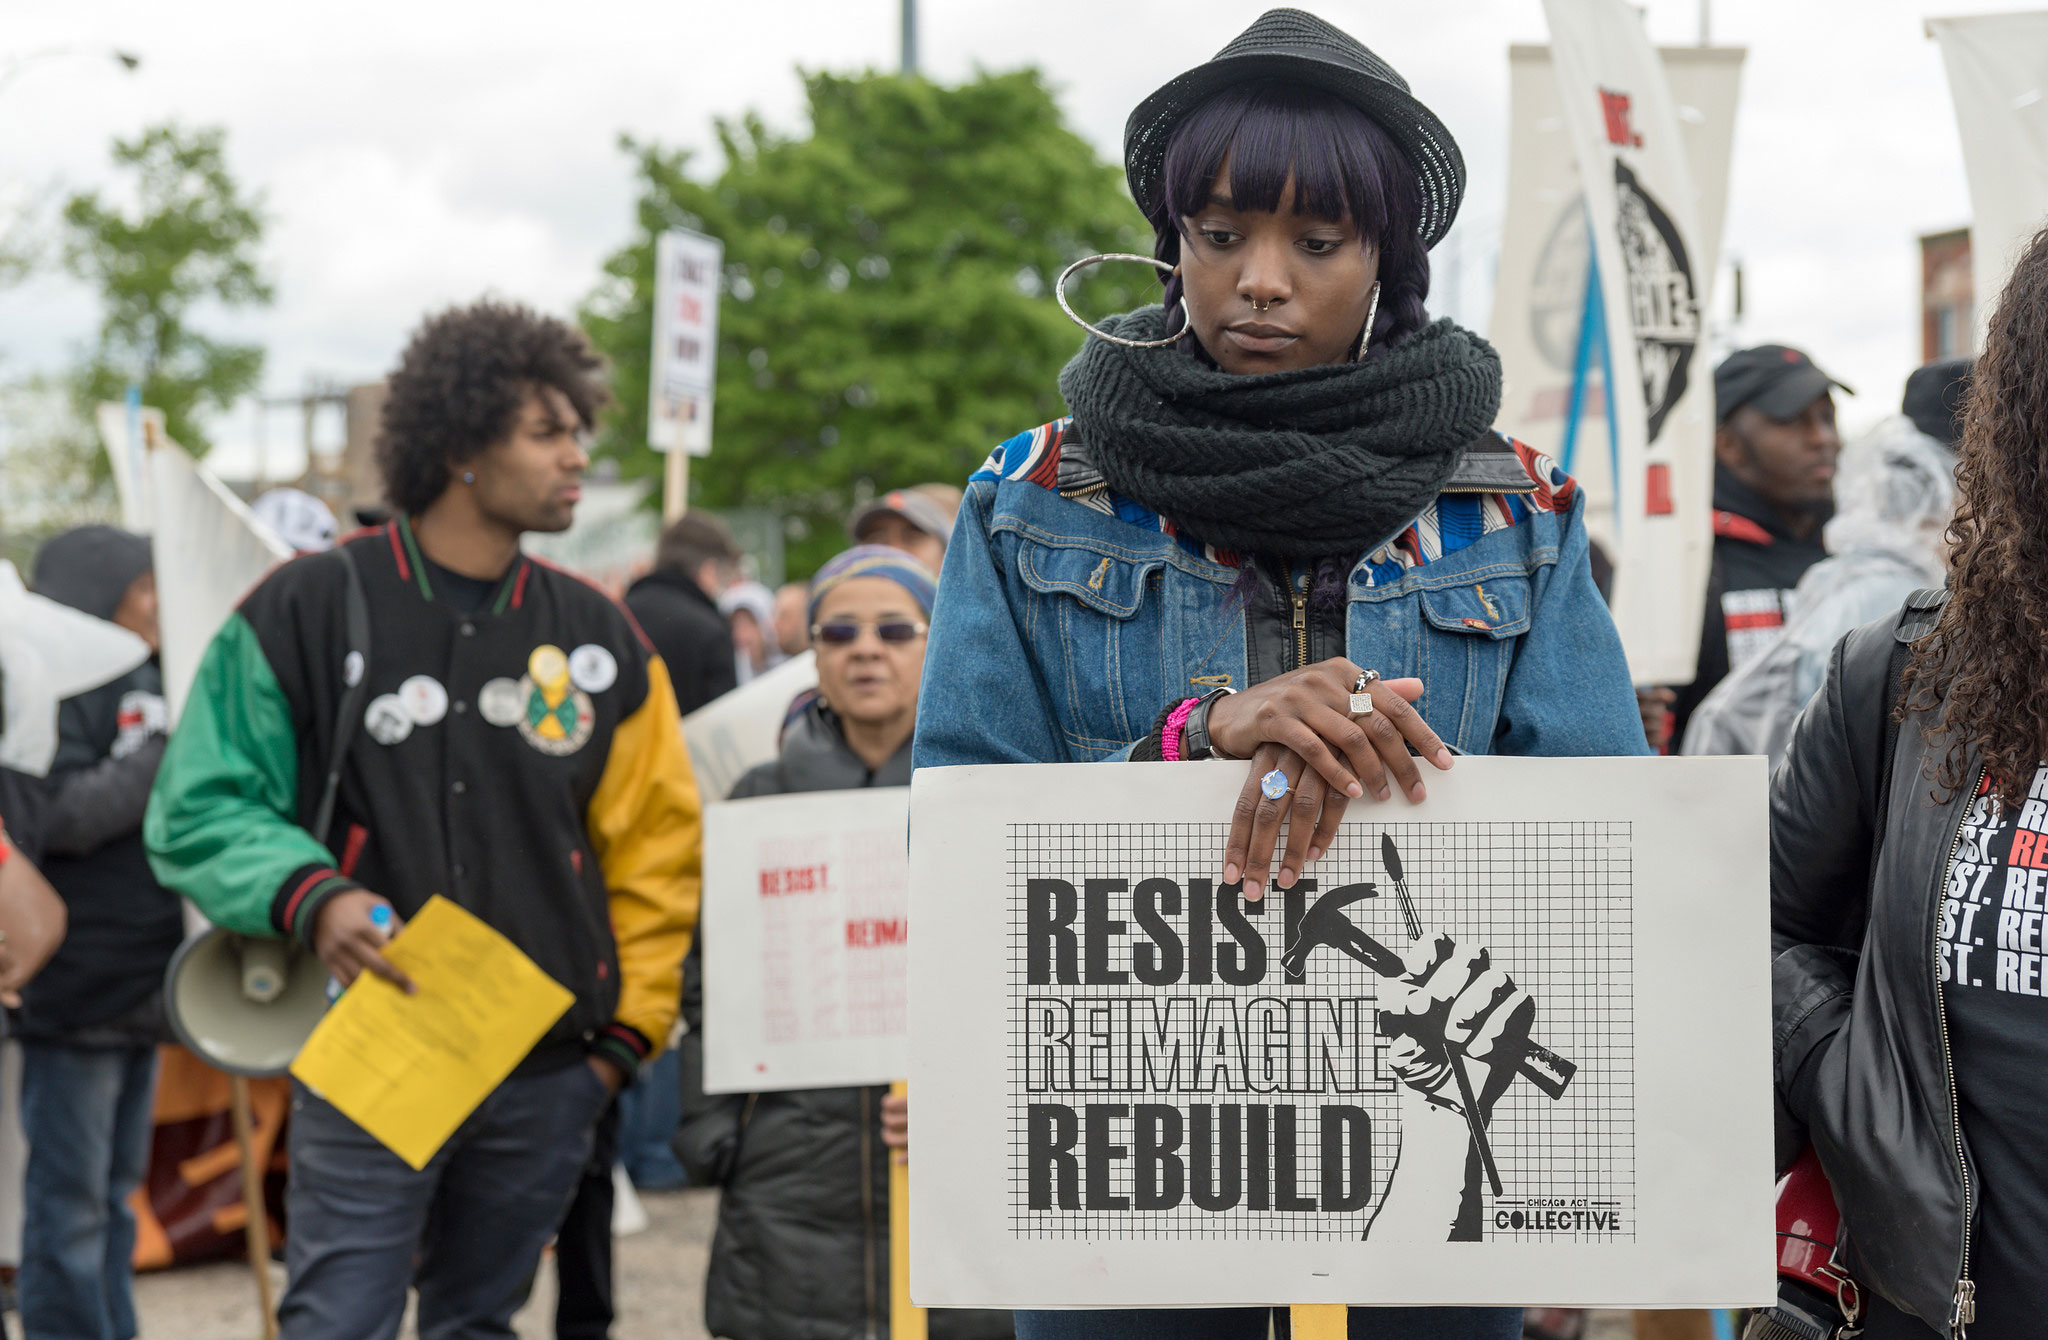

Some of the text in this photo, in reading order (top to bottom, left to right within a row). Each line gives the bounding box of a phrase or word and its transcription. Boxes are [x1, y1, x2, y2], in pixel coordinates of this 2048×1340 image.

[1027, 878, 1318, 986] RESIST
[1026, 997, 1397, 1094] REIMAGINE
[1028, 1103, 1372, 1213] REBUILD
[1527, 1199, 1588, 1207] CHICAGO ACT
[1495, 1210, 1620, 1231] COLLECTIVE
